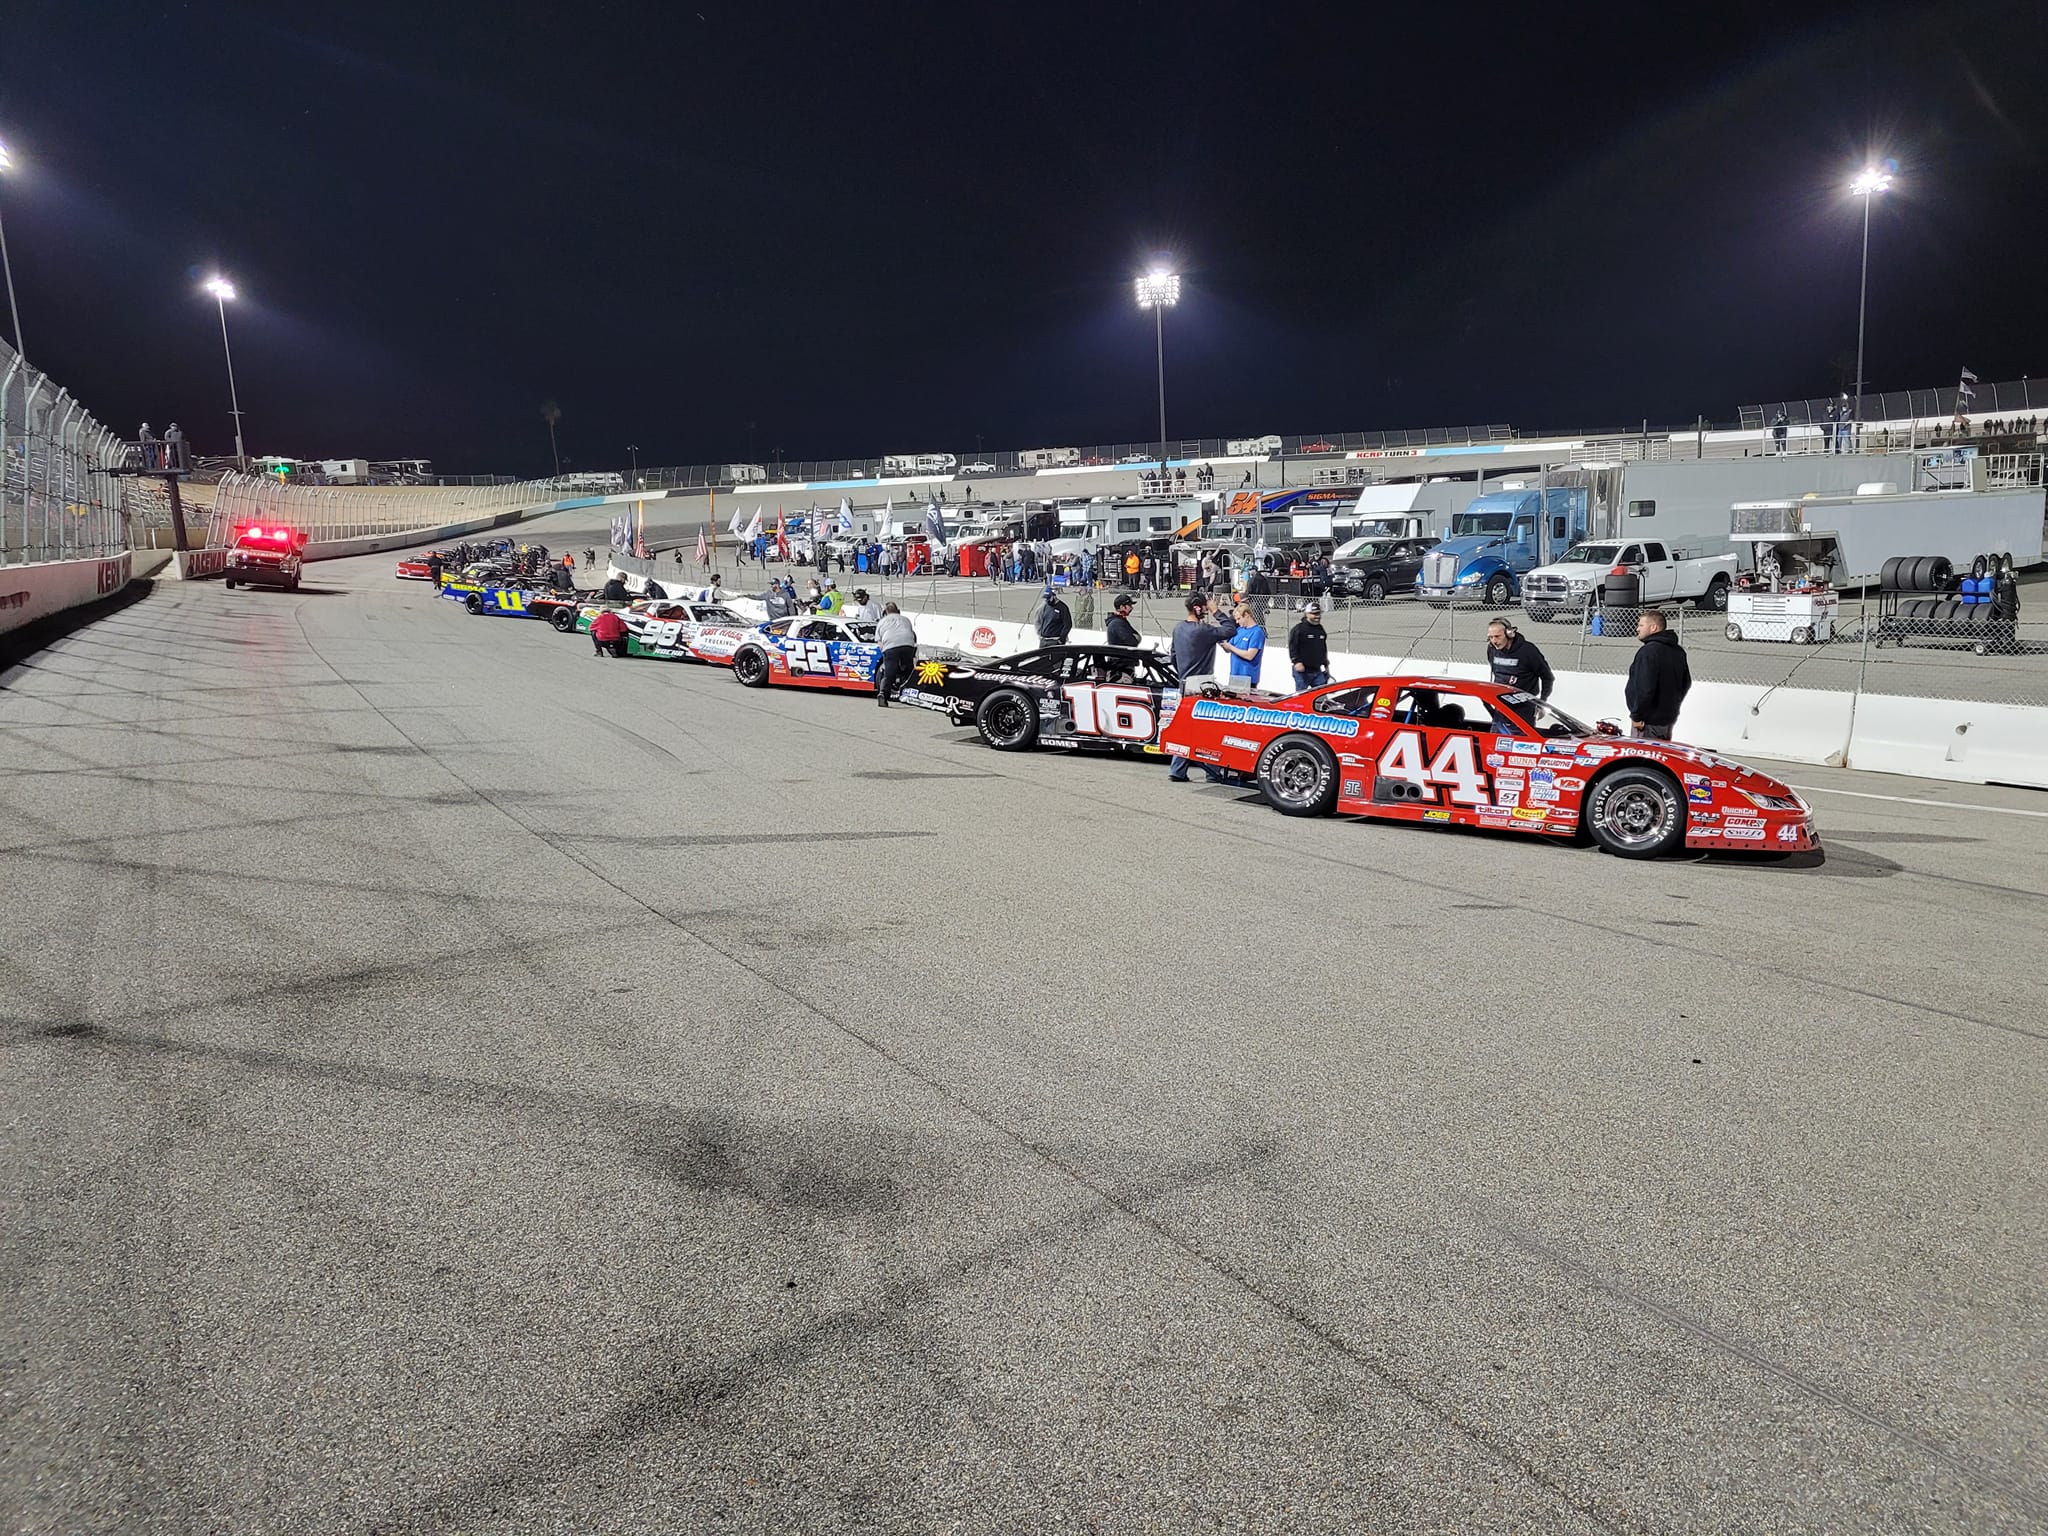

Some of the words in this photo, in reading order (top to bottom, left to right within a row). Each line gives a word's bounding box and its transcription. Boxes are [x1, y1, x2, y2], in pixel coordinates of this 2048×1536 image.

[1227, 491, 1264, 515] 54
[1307, 492, 1336, 500] SIGMA
[495, 590, 526, 611] 11
[639, 620, 682, 647] 98
[784, 640, 832, 673] 22
[949, 666, 1056, 691] Sunnyvalley
[1063, 683, 1155, 741] 16
[1192, 700, 1247, 722] Alliance
[1245, 706, 1290, 729] Rental
[1289, 711, 1360, 738] Solutions
[1040, 739, 1079, 748] GOMES
[1618, 747, 1669, 763] Hoosier
[1259, 743, 1284, 780] Hoosier
[1377, 729, 1489, 804] 44
[1305, 766, 1331, 807] Hoosier
[1500, 792, 1518, 800] 51
[1424, 810, 1451, 819] JOES
[1478, 806, 1510, 815] tilton
[1593, 785, 1612, 829] Hoosier
[1657, 792, 1677, 842] Hoosier
[1689, 826, 1722, 835] PFC
[1727, 818, 1757, 826] COMP
[1777, 825, 1798, 842] 44
